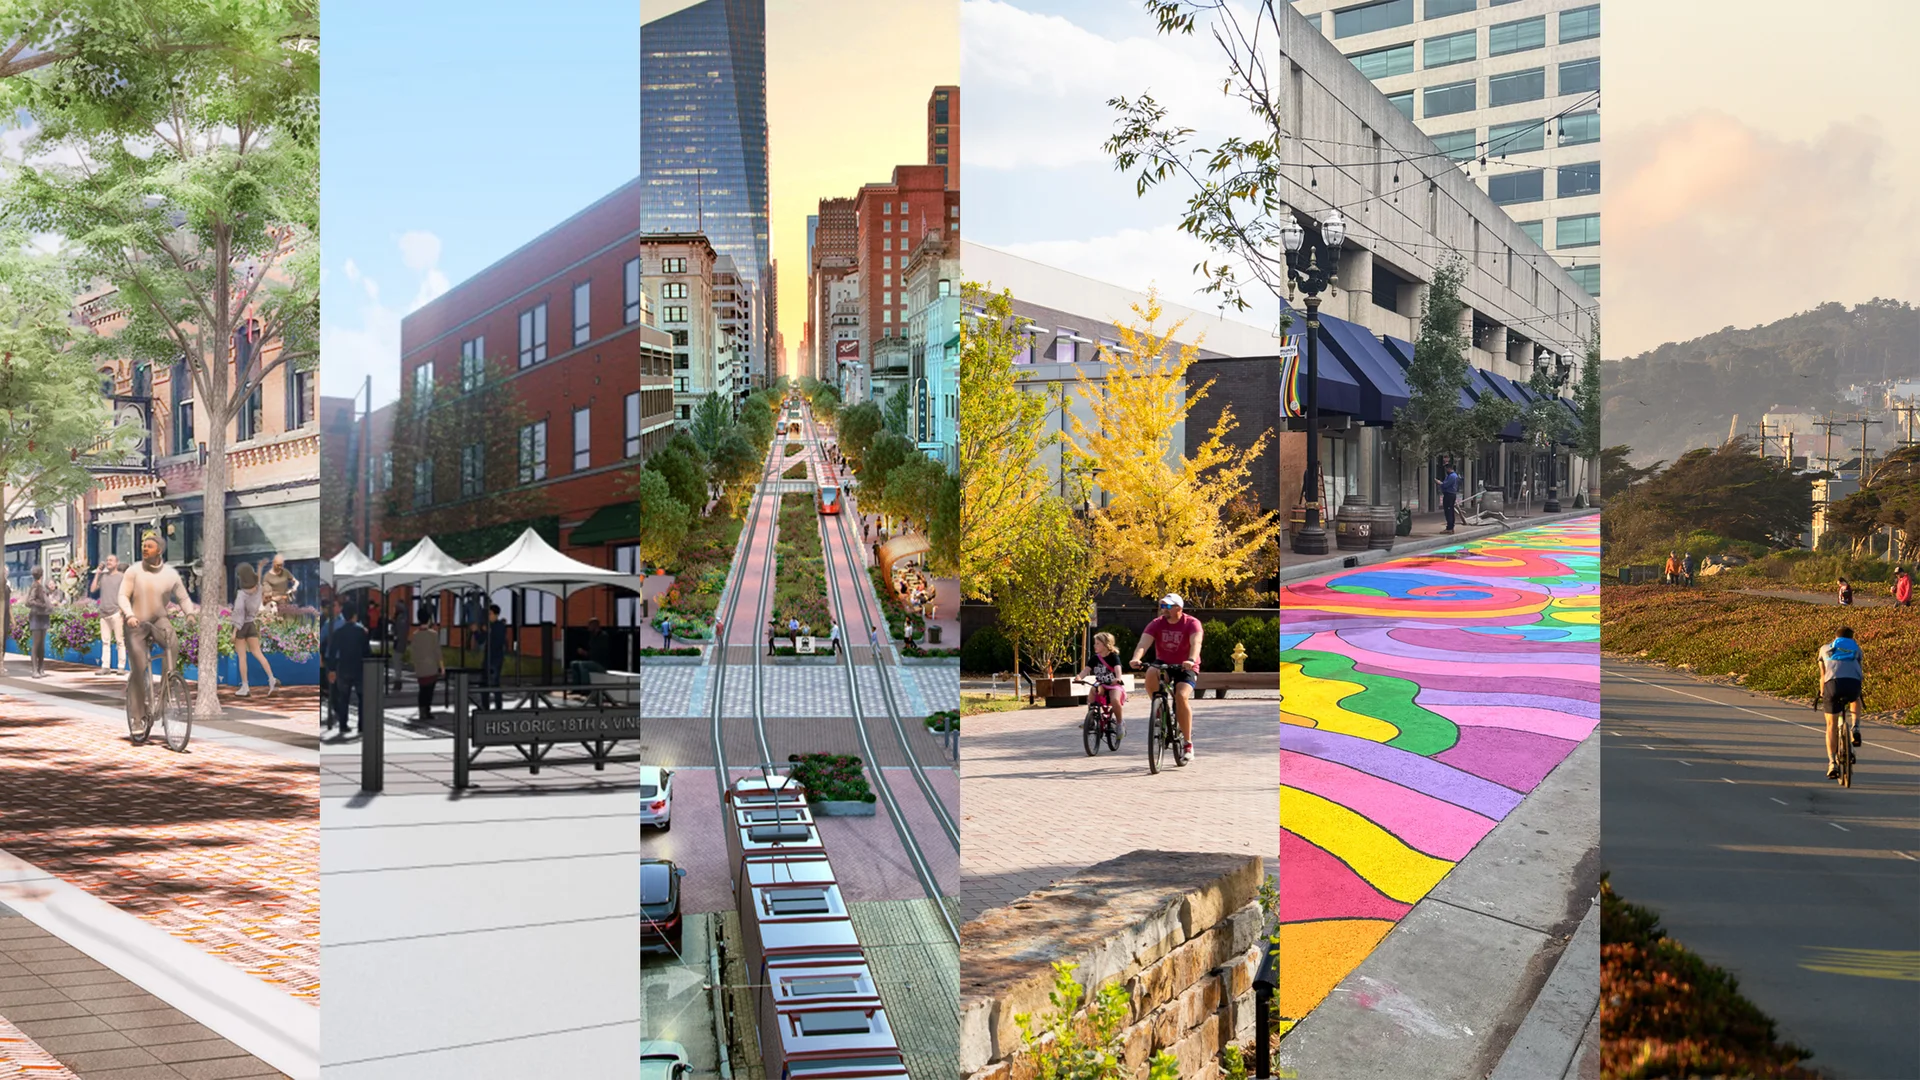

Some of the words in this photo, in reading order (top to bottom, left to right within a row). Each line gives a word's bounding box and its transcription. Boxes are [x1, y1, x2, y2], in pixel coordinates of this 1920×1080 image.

[485, 719, 556, 734] HISTORIC
[562, 718, 596, 731] 18TH
[600, 718, 608, 729] &
